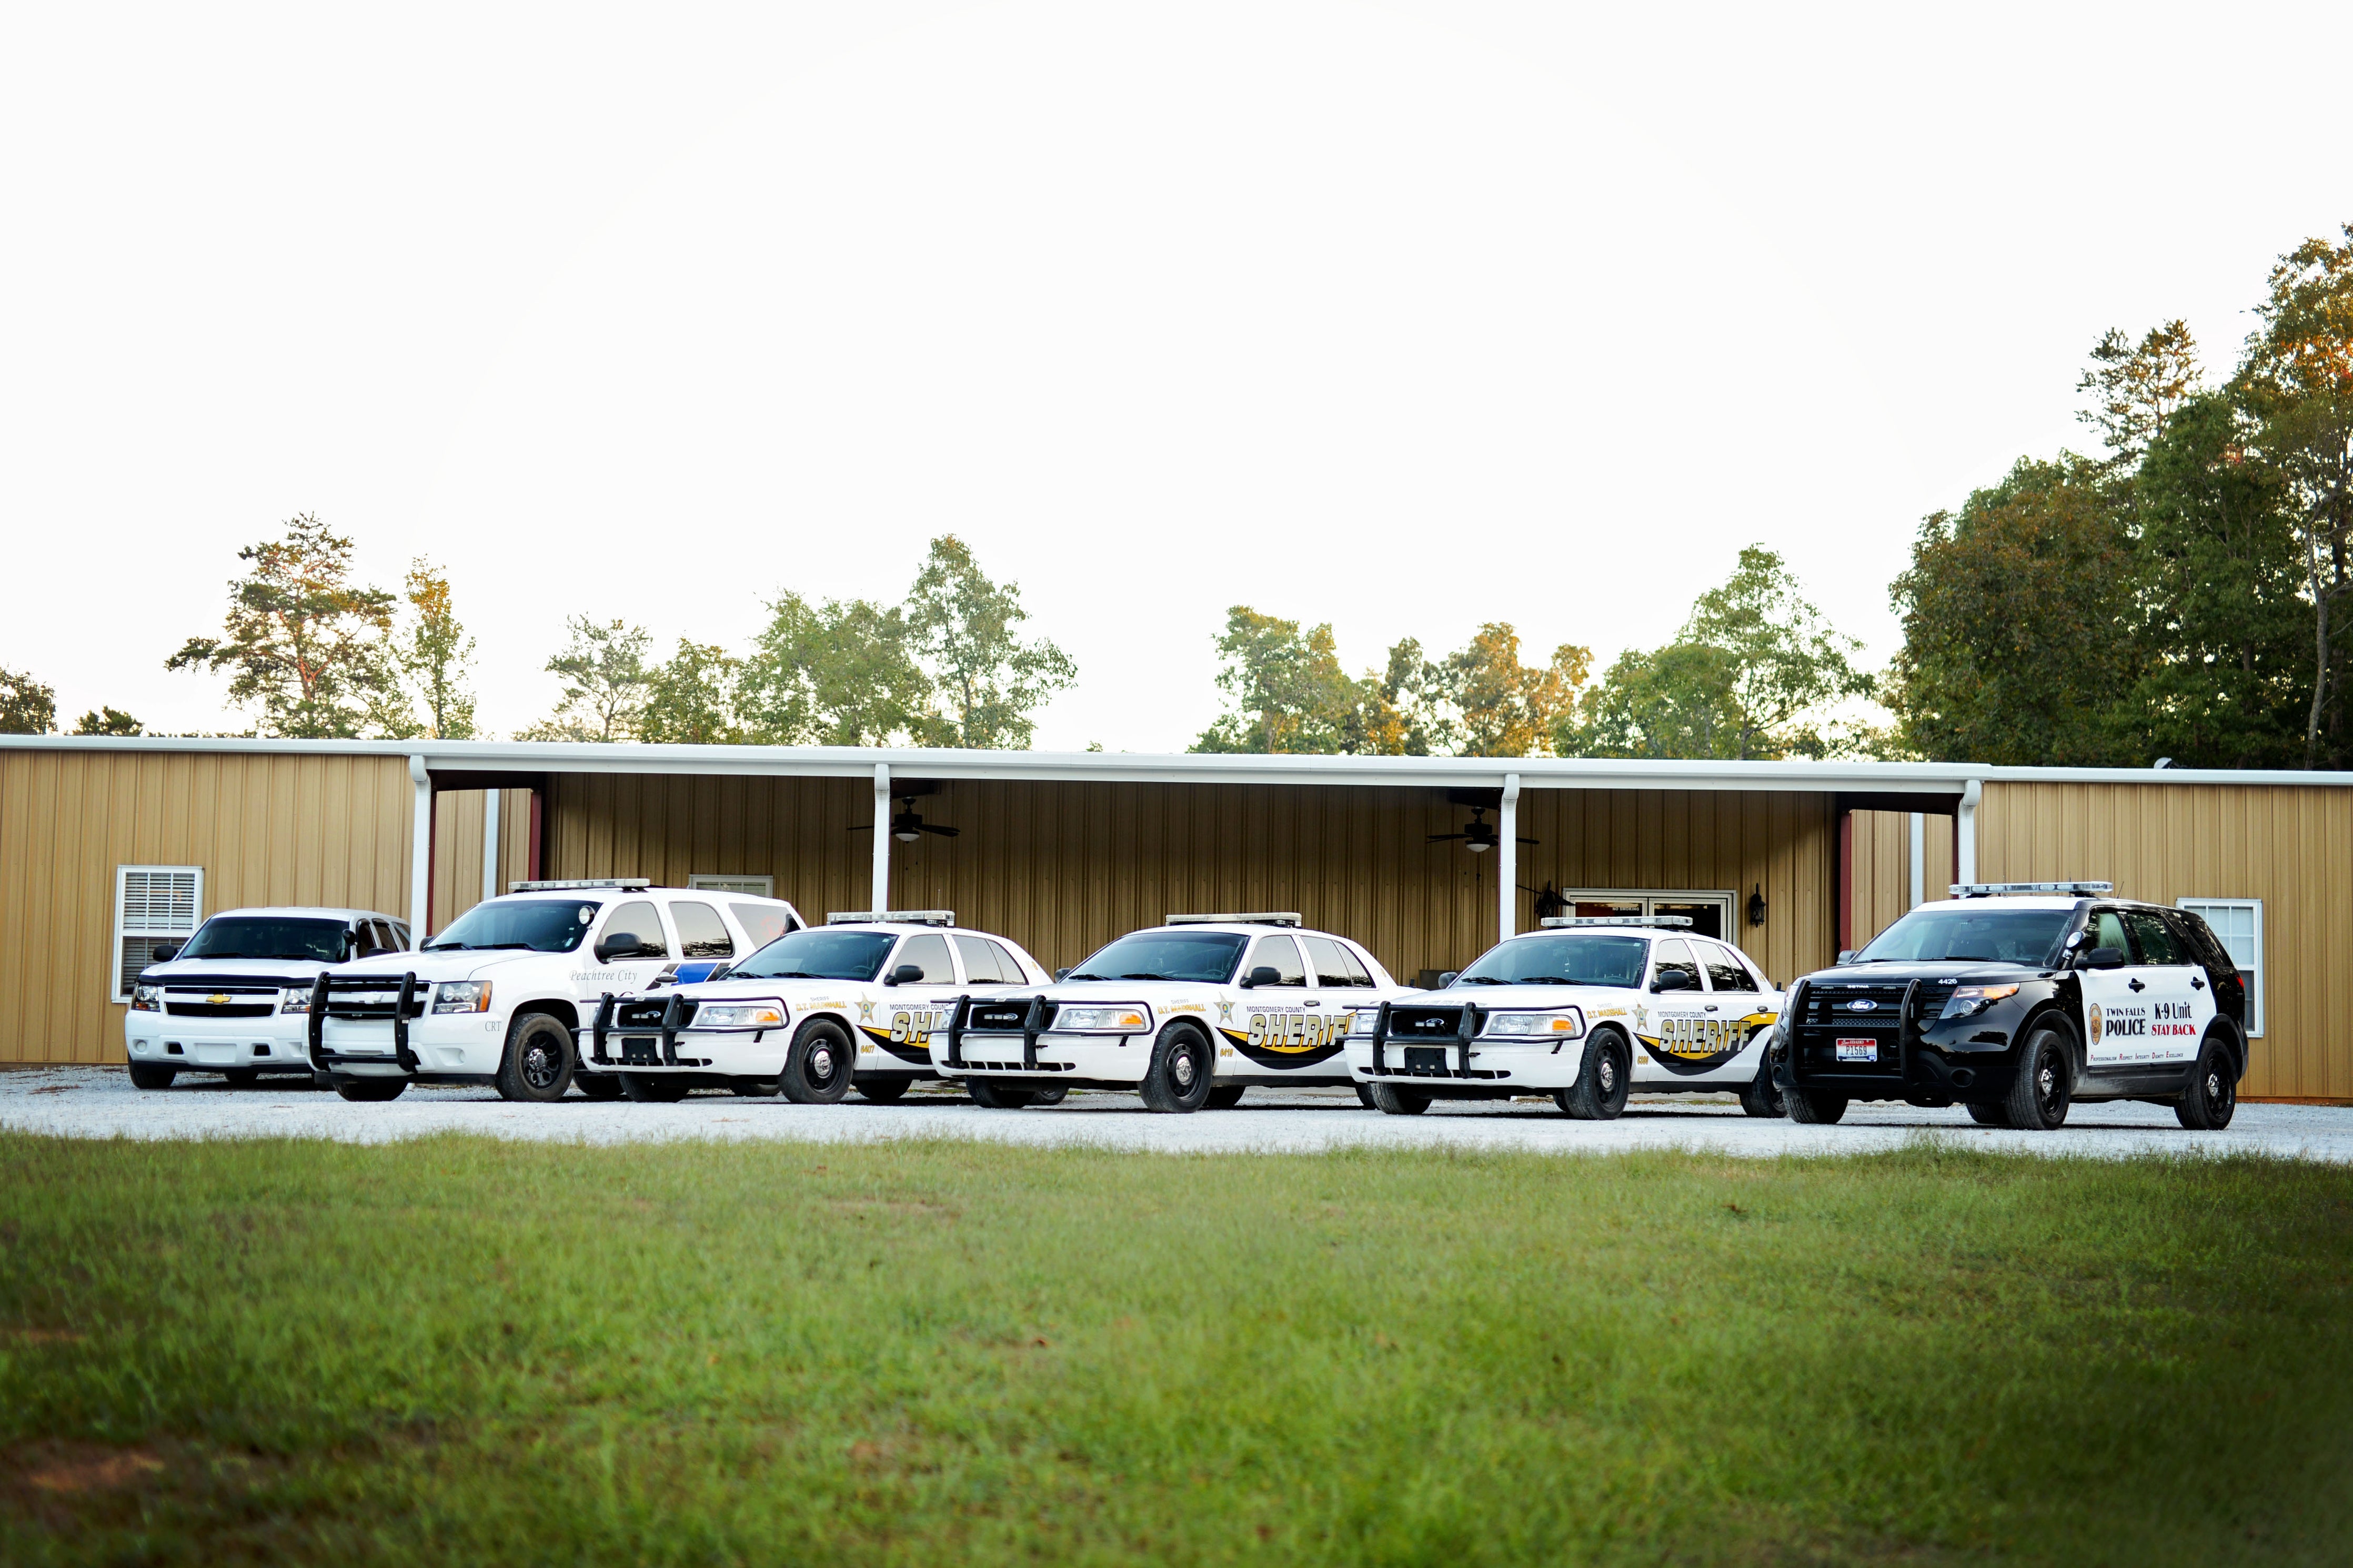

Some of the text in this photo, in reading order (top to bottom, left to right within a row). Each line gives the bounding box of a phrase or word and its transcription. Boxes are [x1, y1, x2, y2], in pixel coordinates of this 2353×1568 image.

[569, 968, 637, 984] Peachtree City
[809, 1001, 847, 1010] MARSHALL
[1158, 1004, 1206, 1014] D.T. MARSHALL
[1852, 1001, 1869, 1009] Ford
[2155, 1001, 2192, 1019] K-9 Unit
[1586, 1007, 1627, 1019] D.T. MARSHALL
[2125, 1007, 2146, 1016] FALLS
[485, 1021, 501, 1031] CRT
[2106, 1018, 2146, 1037] POLICE
[2151, 1024, 2196, 1036] STAY BACK
[1659, 1019, 1751, 1053] SHERIFF
[1846, 1046, 1867, 1055] P1569
